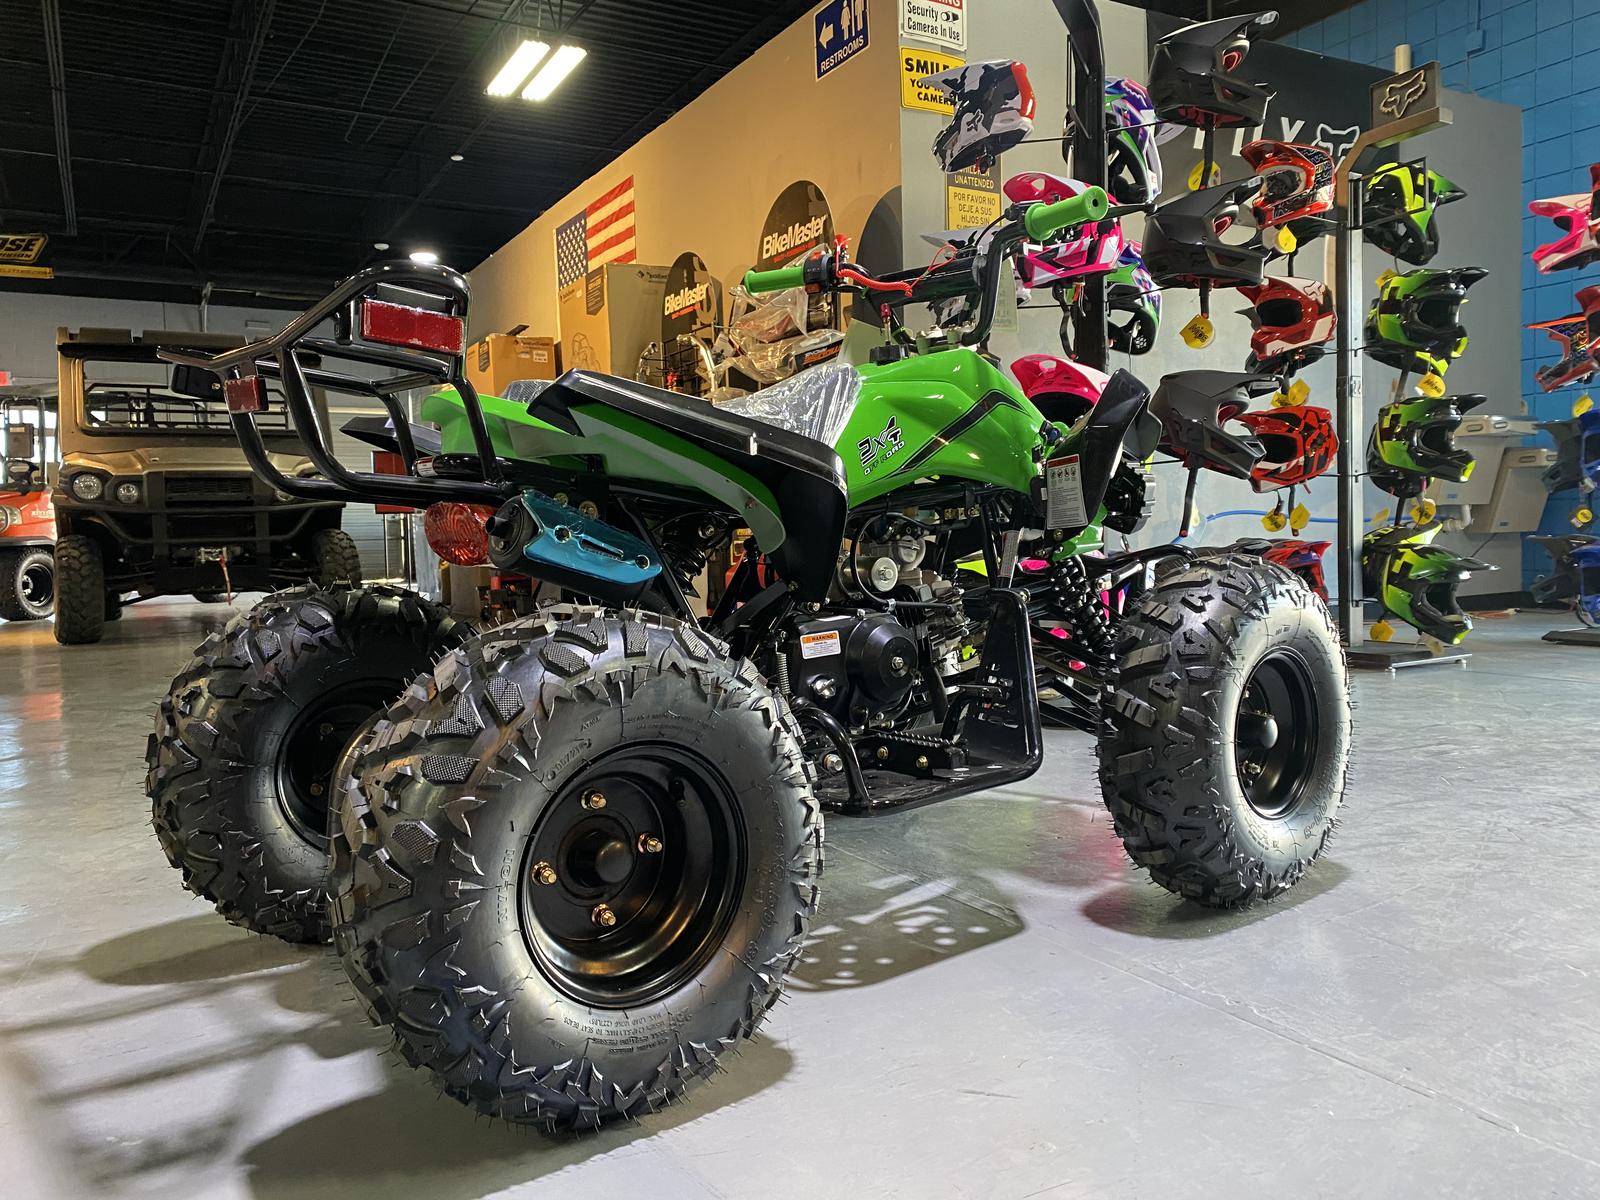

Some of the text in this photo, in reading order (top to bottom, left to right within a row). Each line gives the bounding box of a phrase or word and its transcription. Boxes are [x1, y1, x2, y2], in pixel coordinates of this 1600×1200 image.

[907, 1, 939, 22] Security
[907, 17, 960, 41] Cameras In Use
[820, 35, 864, 73] RESTROOMS
[954, 175, 995, 189] UNATTENDED
[953, 192, 996, 206] POR FAVOR NO
[958, 204, 974, 214] DEJE
[980, 206, 993, 217] SUS
[960, 214, 979, 224] HIJOS
[762, 214, 828, 260] BikeMaster
[664, 282, 709, 316] BikeMaster
[880, 440, 905, 463] ROAD
